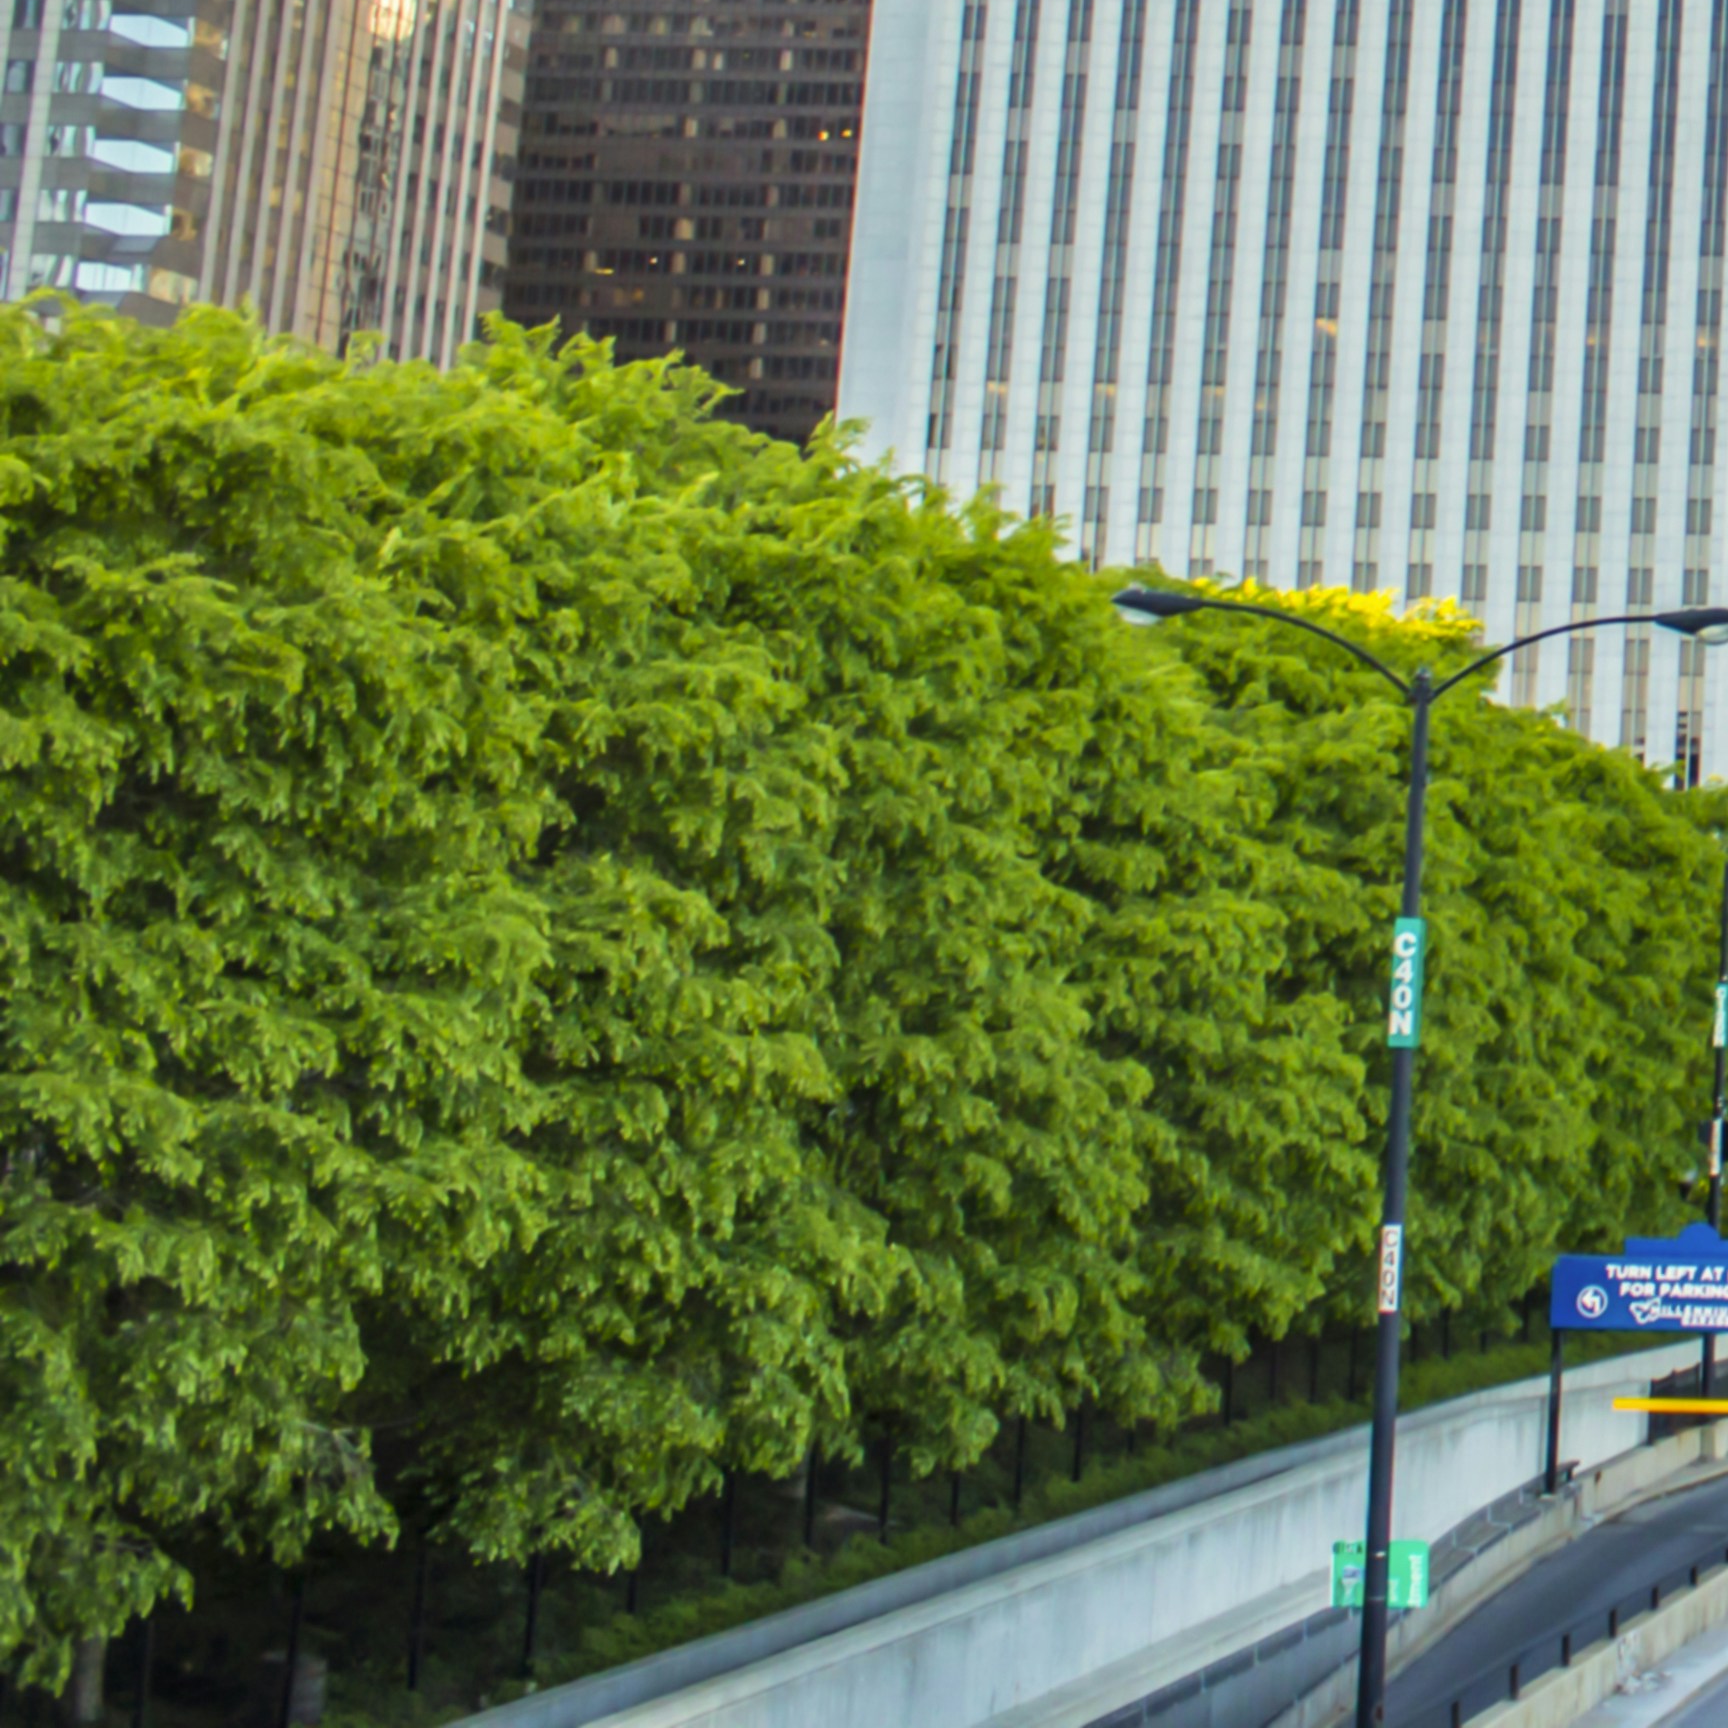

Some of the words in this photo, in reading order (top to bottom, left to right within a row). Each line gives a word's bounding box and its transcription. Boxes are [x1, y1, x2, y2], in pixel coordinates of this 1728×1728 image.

[1389, 931, 1417, 1036] C40N
[1380, 1229, 1398, 1306] C40N
[1606, 1263, 1653, 1280] TURN
[1655, 1264, 1698, 1281] LEFT
[1701, 1265, 1725, 1282] AT
[1619, 1281, 1656, 1297] FOR
